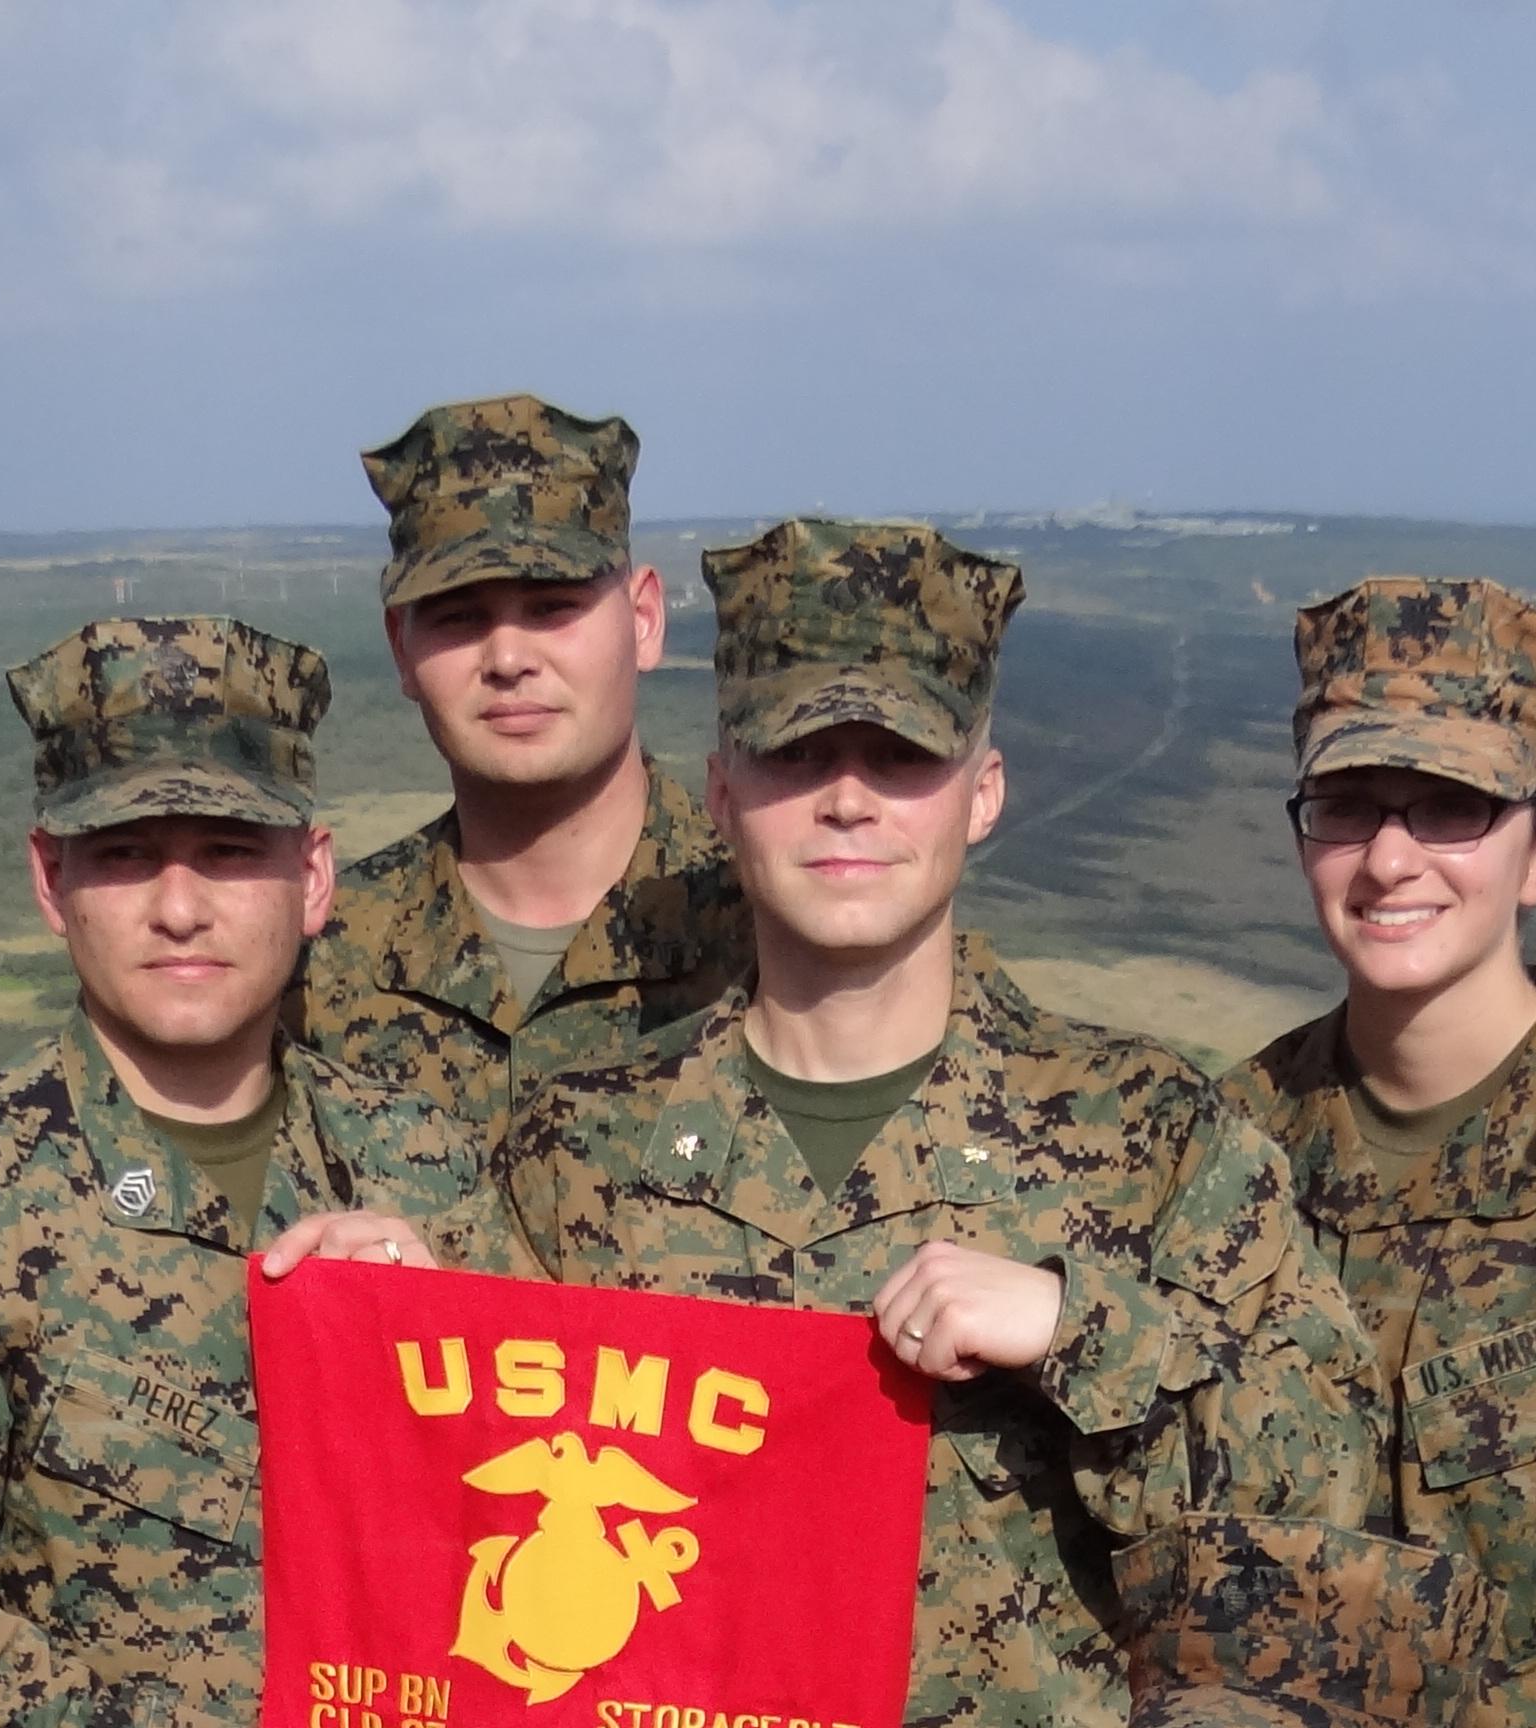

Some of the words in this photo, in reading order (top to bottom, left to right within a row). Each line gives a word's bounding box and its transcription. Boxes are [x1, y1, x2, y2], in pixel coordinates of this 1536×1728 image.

[127, 1374, 223, 1442] PEREZ
[396, 1337, 769, 1455] USMC
[1418, 1354, 1471, 1399] U.S.
[310, 1662, 387, 1706] SUP
[400, 1673, 451, 1720] BN
